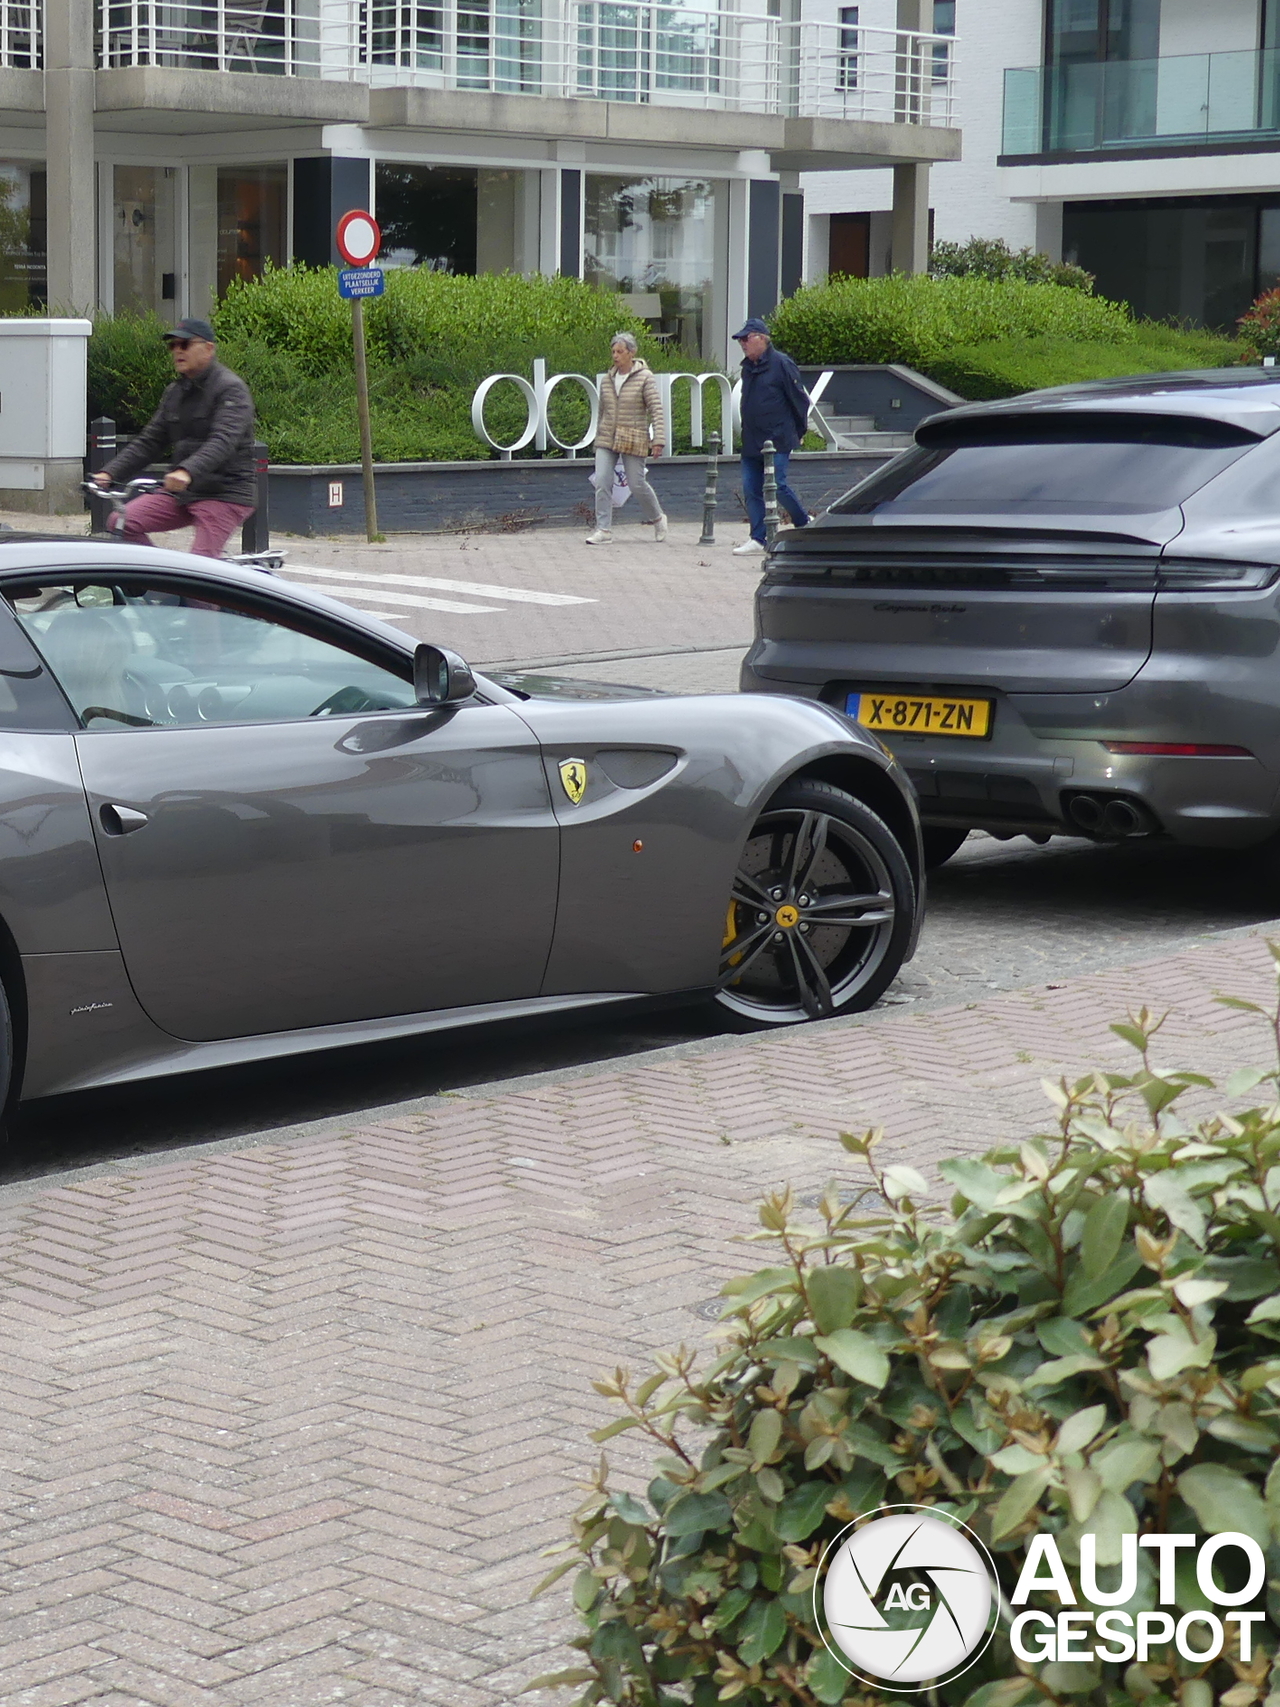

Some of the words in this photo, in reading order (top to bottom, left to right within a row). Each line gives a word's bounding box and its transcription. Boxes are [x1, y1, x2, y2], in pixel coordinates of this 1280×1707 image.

[342, 271, 381, 281] UITGEZONDERD
[344, 278, 379, 289] PLAATSELIJK
[350, 286, 375, 296] VERKEER
[472, 358, 838, 457] obmx
[869, 699, 974, 730] X-871-ZN
